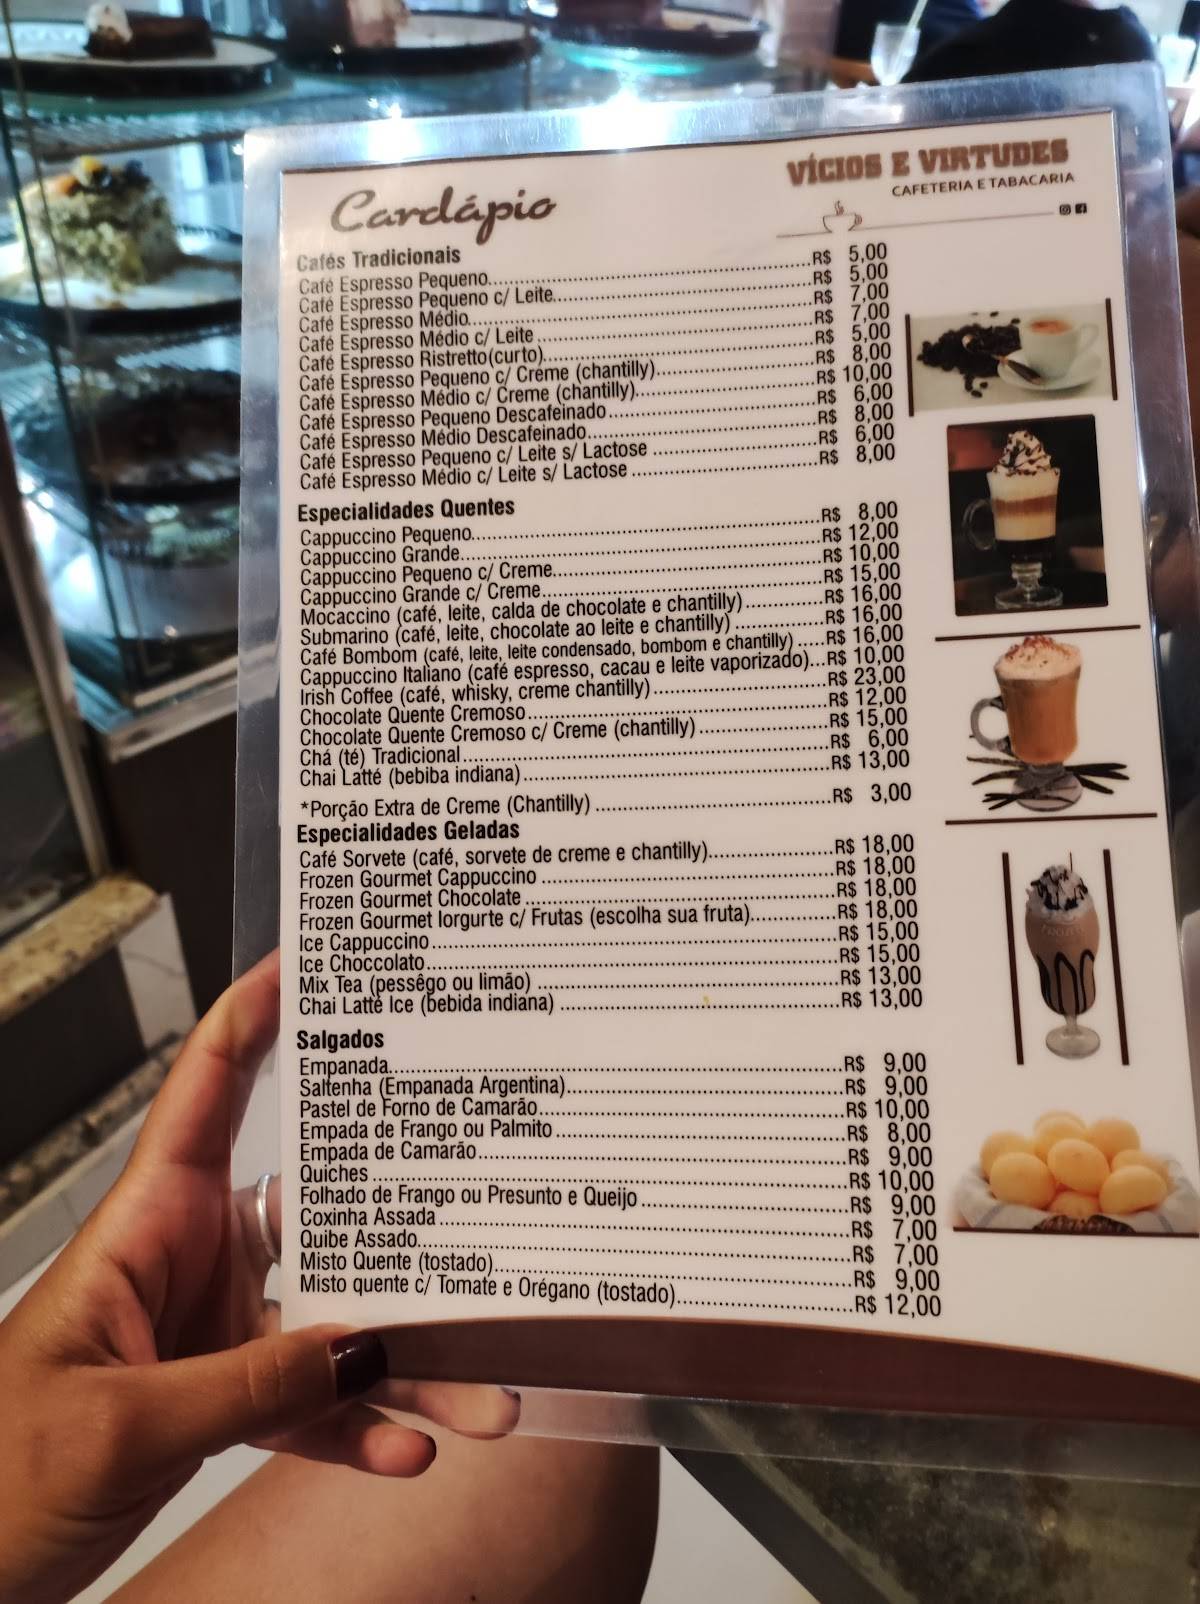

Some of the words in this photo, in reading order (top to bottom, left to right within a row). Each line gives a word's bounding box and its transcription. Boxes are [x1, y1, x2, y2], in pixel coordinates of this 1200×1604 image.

[786, 152, 883, 187] VÍCIOS
[891, 150, 910, 177] E
[918, 138, 1069, 175] VIRTUDES
[891, 179, 973, 197] CAFETERIA
[977, 178, 986, 190] E
[990, 171, 1075, 188] TABACARIA
[331, 186, 557, 246] Cardápio
[354, 247, 461, 268] Tradicionais
[298, 334, 334, 352] Café
[340, 334, 414, 353] Espresso
[418, 329, 469, 347] Médio
[474, 327, 490, 346] c/
[494, 326, 534, 343] Leite
[815, 310, 833, 326] R$
[851, 303, 890, 323] 7,00
[298, 354, 334, 371] Café
[340, 353, 414, 373] Espresso
[419, 346, 545, 368] Ristretto(curto)
[815, 330, 834, 346] R$
[851, 323, 891, 343] 5,00
[298, 412, 336, 430] Café
[340, 412, 416, 432] Espresso
[420, 409, 490, 428] Pequeno
[495, 402, 606, 422] Descafeinado
[817, 390, 836, 406] R$
[854, 383, 893, 403] 6,00
[298, 452, 336, 470] Café
[340, 451, 416, 471] Espresso
[420, 448, 492, 468] Pequeno
[496, 445, 512, 463] c/
[518, 443, 556, 461] Leite
[561, 442, 578, 460] s/
[582, 441, 648, 458] Lactose
[819, 430, 837, 446] R$
[855, 424, 894, 443] 6,00
[296, 500, 434, 525] Especialidades
[440, 499, 515, 517] Quentes
[299, 547, 396, 569] Cappuccino
[401, 544, 461, 562] Grande
[823, 528, 841, 543] R$
[849, 522, 899, 543] 12,00
[300, 605, 390, 624] Mocaccino
[396, 603, 441, 625] (café,
[447, 602, 485, 621] leite,
[490, 600, 535, 618] calda
[540, 599, 560, 616] de
[565, 597, 646, 615] chocolate
[650, 600, 662, 612] e
[666, 593, 742, 614] chantilly)
[825, 590, 844, 605] R$
[852, 584, 902, 605] 16,00
[299, 666, 398, 689] Cappuccino
[402, 664, 462, 682] Italiano
[466, 661, 508, 683] (café
[512, 663, 594, 681] espresso,
[600, 661, 650, 675] cacau
[654, 660, 666, 673] e
[670, 655, 705, 672] leite
[709, 651, 810, 674] vaporizado)
[827, 652, 846, 667] R$
[855, 646, 905, 667] 10,00
[299, 727, 382, 745] Chocolate
[386, 726, 445, 744] Quente
[450, 724, 526, 741] Cremoso
[530, 722, 548, 741] c/
[552, 722, 608, 739] Creme
[612, 719, 696, 742] (chantilly)
[830, 713, 849, 729] R$
[858, 708, 908, 729] 15,00
[296, 822, 438, 846] Especialidades
[442, 821, 520, 840] Geladas
[298, 849, 336, 867] Café
[342, 849, 406, 866] Sorvete
[412, 847, 458, 869] (café,
[464, 847, 526, 864] sorvete
[531, 845, 552, 862] de
[556, 848, 610, 862] creme
[614, 848, 626, 861] e
[630, 842, 709, 863] chantilly)
[835, 839, 854, 854] R$
[862, 834, 914, 855] 18,00
[298, 871, 354, 888] Frozen
[358, 870, 432, 887] Gourmet
[436, 867, 536, 890] Cappuccino
[836, 861, 856, 876] R$
[863, 856, 915, 877] 18,00
[298, 912, 354, 930] Frozen
[359, 911, 432, 928] Gourmet
[438, 910, 504, 931] Iorgurte
[508, 908, 526, 927] c/
[530, 908, 584, 925] Frutas
[588, 906, 662, 929] (escolha
[666, 910, 698, 923] sua
[702, 904, 751, 926] fruta)
[838, 904, 858, 920] R$
[865, 900, 918, 921] 18,00
[298, 975, 329, 993] Mix
[337, 975, 363, 992] Tea
[368, 974, 447, 996] (pessêgo
[451, 978, 473, 991] ou
[478, 973, 531, 995] limão)
[841, 970, 860, 986] R$
[868, 966, 921, 987] 13,00
[296, 1030, 384, 1053] Salgados
[298, 1077, 372, 1095] Saltenha
[378, 1076, 474, 1099] (Empanada
[478, 1076, 566, 1098] Argentina)
[846, 1079, 866, 1096] R$
[885, 1076, 928, 1098] 9,00
[299, 1099, 350, 1117] Pastel
[355, 1099, 376, 1117] de
[382, 1099, 430, 1117] Forno
[434, 1098, 456, 1116] de
[460, 1098, 538, 1116] Camarão
[847, 1102, 867, 1119] R$
[874, 1099, 929, 1121] 10,00
[299, 1121, 368, 1143] Empada
[373, 1121, 394, 1138] de
[400, 1121, 458, 1142] Frango
[462, 1124, 484, 1138] ou
[490, 1120, 552, 1138] Palmito
[848, 1125, 868, 1143] R$
[887, 1122, 931, 1144] 8,00
[300, 1185, 366, 1204] Folhado
[370, 1186, 392, 1204] de
[398, 1186, 456, 1209] Frango
[460, 1191, 482, 1205] ou
[486, 1187, 562, 1205] Presunto
[566, 1192, 578, 1205] e
[582, 1188, 638, 1210] Queijo
[851, 1197, 872, 1215] R$
[891, 1195, 935, 1217] 9,00
[299, 1208, 368, 1226] Coxinha
[372, 1208, 436, 1226] Assada
[852, 1221, 873, 1239] R$
[893, 1219, 937, 1242] 7,00
[300, 1252, 347, 1270] Misto
[352, 1253, 412, 1271] Quente
[418, 1253, 495, 1276] (tostado)
[854, 1271, 875, 1290] R$
[895, 1269, 940, 1292] 9,00
[300, 1275, 347, 1293] Misto
[352, 1278, 408, 1298] quente
[414, 1278, 430, 1298] c/
[440, 1278, 497, 1298] Tomate
[502, 1285, 512, 1298] e
[518, 1281, 590, 1304] Orégano
[596, 1283, 677, 1307] (tostado)
[856, 1296, 876, 1315] R$
[884, 1294, 941, 1318] 12,00
